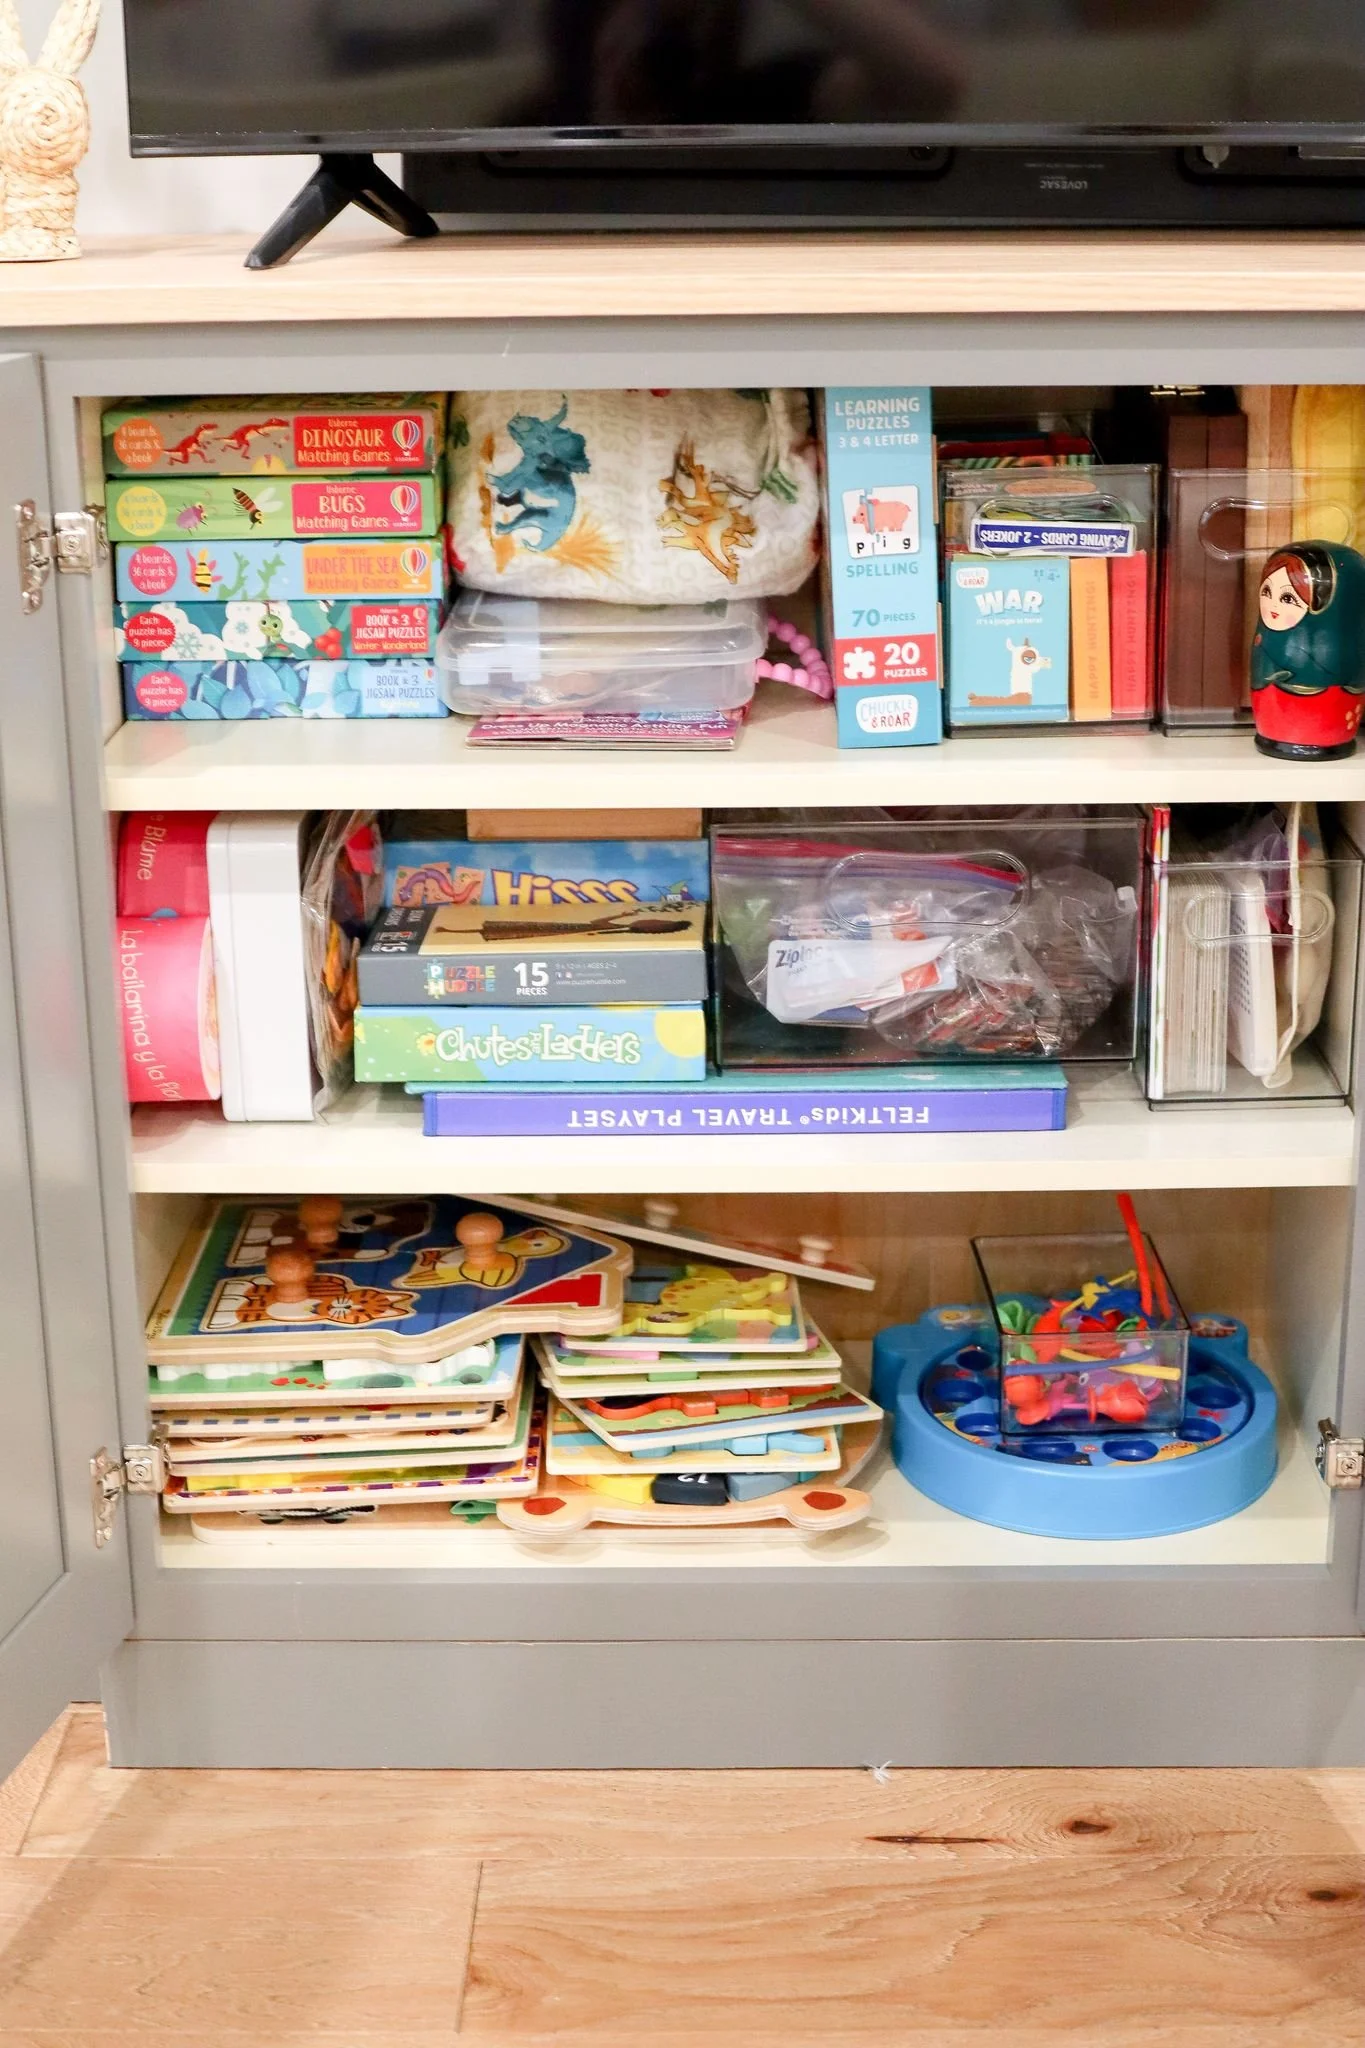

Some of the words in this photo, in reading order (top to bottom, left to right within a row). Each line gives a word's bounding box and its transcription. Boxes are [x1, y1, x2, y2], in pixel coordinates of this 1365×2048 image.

[1040, 180, 1088, 190] LOVESAC
[835, 397, 921, 416] LEARNING
[846, 415, 910, 431] PUZZLES
[302, 428, 385, 448] DINOSAUR
[839, 437, 847, 448] 3
[850, 436, 859, 447] &
[863, 436, 871, 447] 4
[875, 434, 919, 446] LETTER
[298, 450, 350, 465] Matching
[353, 449, 391, 462] Games
[319, 495, 366, 513] BUGS
[296, 516, 349, 531] Matching
[351, 516, 389, 528] Games
[980, 530, 1022, 543] JOKERS
[1024, 531, 1031, 543] 2
[1041, 532, 1078, 545] CARDS
[306, 557, 346, 574] UNDER
[352, 557, 374, 574] THE
[377, 557, 398, 574] SEA
[846, 562, 919, 578] SPELLING
[307, 578, 358, 592] Matching
[362, 577, 398, 589] Games
[974, 589, 1043, 616] WAR
[140, 616, 159, 625] Each
[366, 615, 389, 626] BOOK
[402, 615, 410, 626] 3
[852, 609, 881, 627] 70
[883, 612, 916, 622] PIECES
[1085, 580, 1099, 650] HUNTING!
[129, 627, 156, 637] puzzle
[157, 626, 172, 635] has
[355, 628, 387, 639] JIGSAW
[388, 628, 426, 639] PUZZLES
[883, 642, 920, 666] 20
[883, 667, 928, 678] PUZZLES
[1087, 656, 1100, 699] HAPPY
[1126, 648, 1137, 692] HAPPY
[151, 675, 170, 684] Each
[376, 675, 399, 686] BOOK
[412, 675, 419, 686] 3
[140, 686, 167, 697] puzzle
[169, 686, 183, 695] has
[366, 688, 395, 699] JIGSAW
[399, 687, 435, 699] PUZZLES
[860, 699, 912, 722] CHUCKLE
[880, 711, 911, 728] ROAR
[137, 825, 167, 880] Blume
[490, 868, 643, 905] Hisss
[121, 929, 143, 950] La
[429, 964, 496, 979] PUZZLE
[513, 962, 549, 987] 15
[431, 979, 496, 994] HUDDLE
[516, 988, 548, 996] PIECES
[121, 953, 151, 1046] bailarina
[436, 1027, 532, 1066] Chutes
[540, 1023, 641, 1065] Ladders
[132, 1051, 155, 1063] y
[146, 1065, 166, 1080] la
[567, 1109, 682, 1128] PLAYSET
[692, 1108, 792, 1126] TRAVEL
